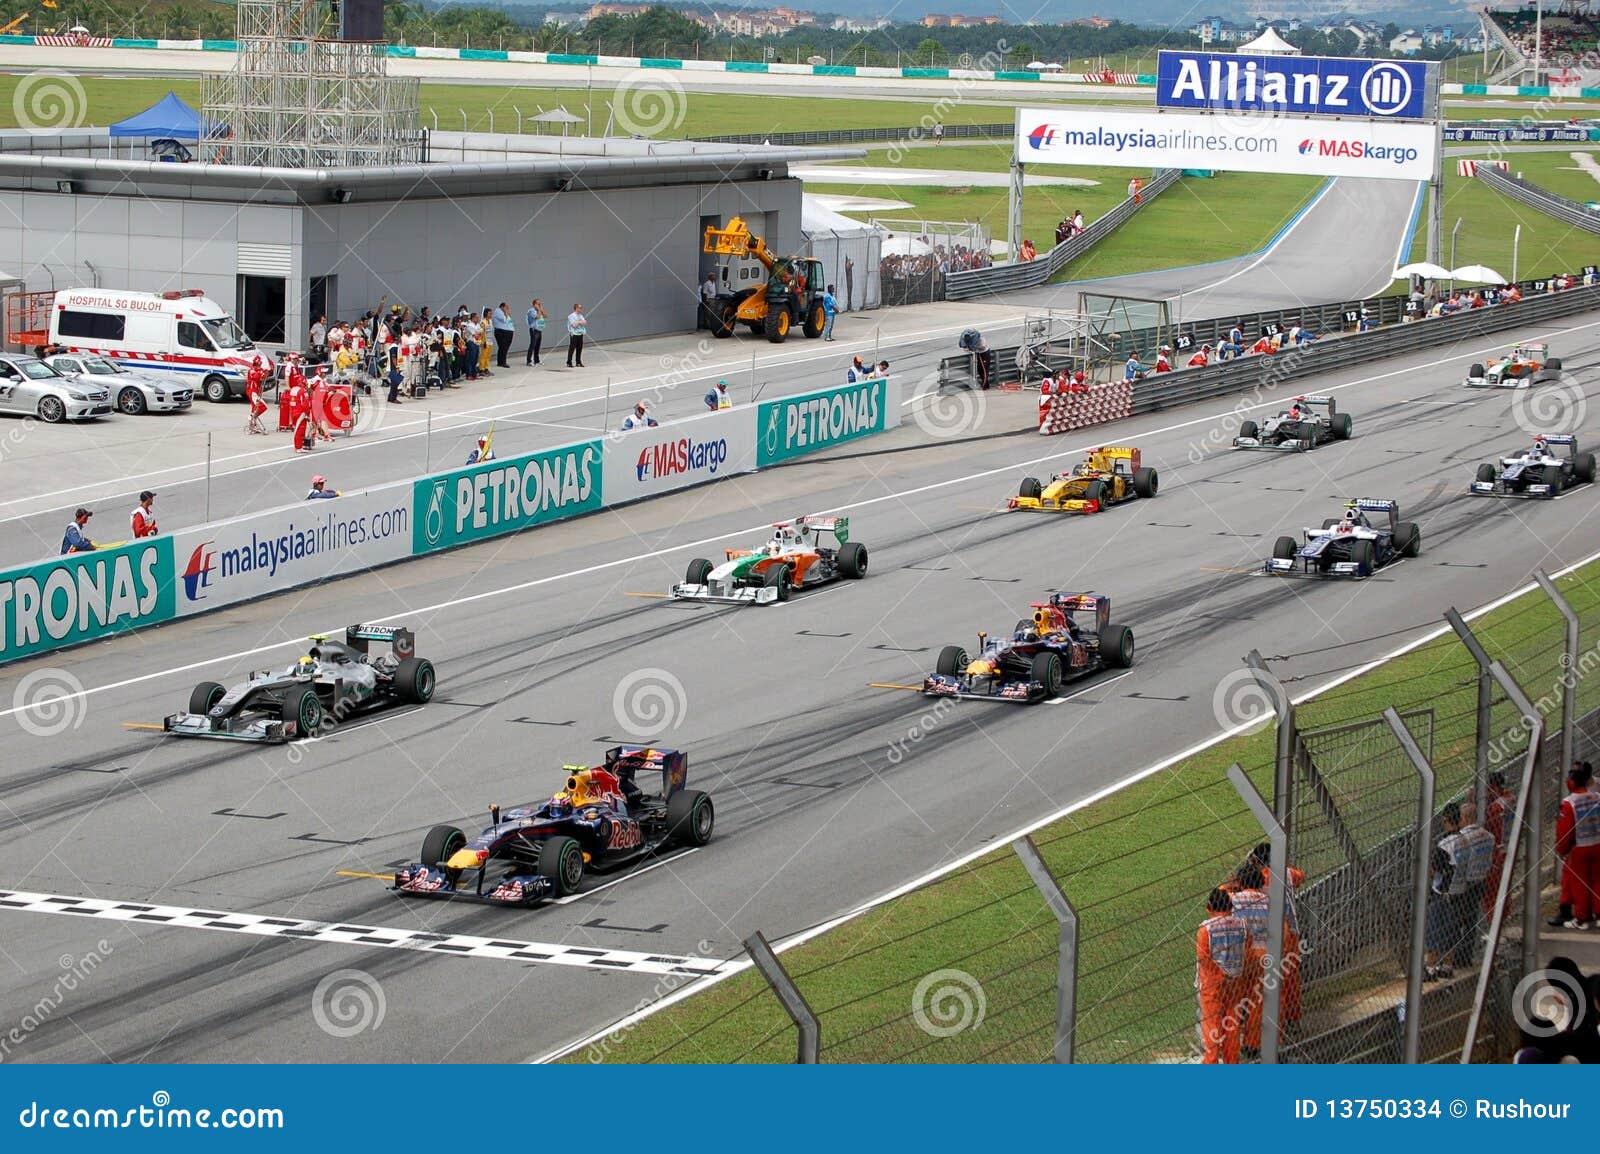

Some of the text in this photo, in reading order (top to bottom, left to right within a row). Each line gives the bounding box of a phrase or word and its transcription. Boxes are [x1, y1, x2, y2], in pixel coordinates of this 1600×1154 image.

[1171, 58, 1350, 107] Allianz
[1065, 126, 1278, 154] malaysiaairlines.com
[1470, 130, 1497, 141] Allianz
[1552, 130, 1579, 140] Allianz
[1318, 138, 1418, 164] MASkargo
[1535, 282, 1545, 290] 17
[1484, 290, 1494, 299] 16
[68, 295, 162, 312] HOSPITAL SG BULOH
[1405, 302, 1417, 311] 22
[1346, 311, 1357, 321] 12
[1266, 324, 1278, 335] 15
[1177, 336, 1190, 348] 23
[786, 383, 880, 450] PETRONAS
[653, 438, 727, 479] MASkargo
[456, 447, 593, 534] PETRONAS
[221, 507, 408, 577] malaysiaairlines.com
[359, 624, 393, 634] PETRON
